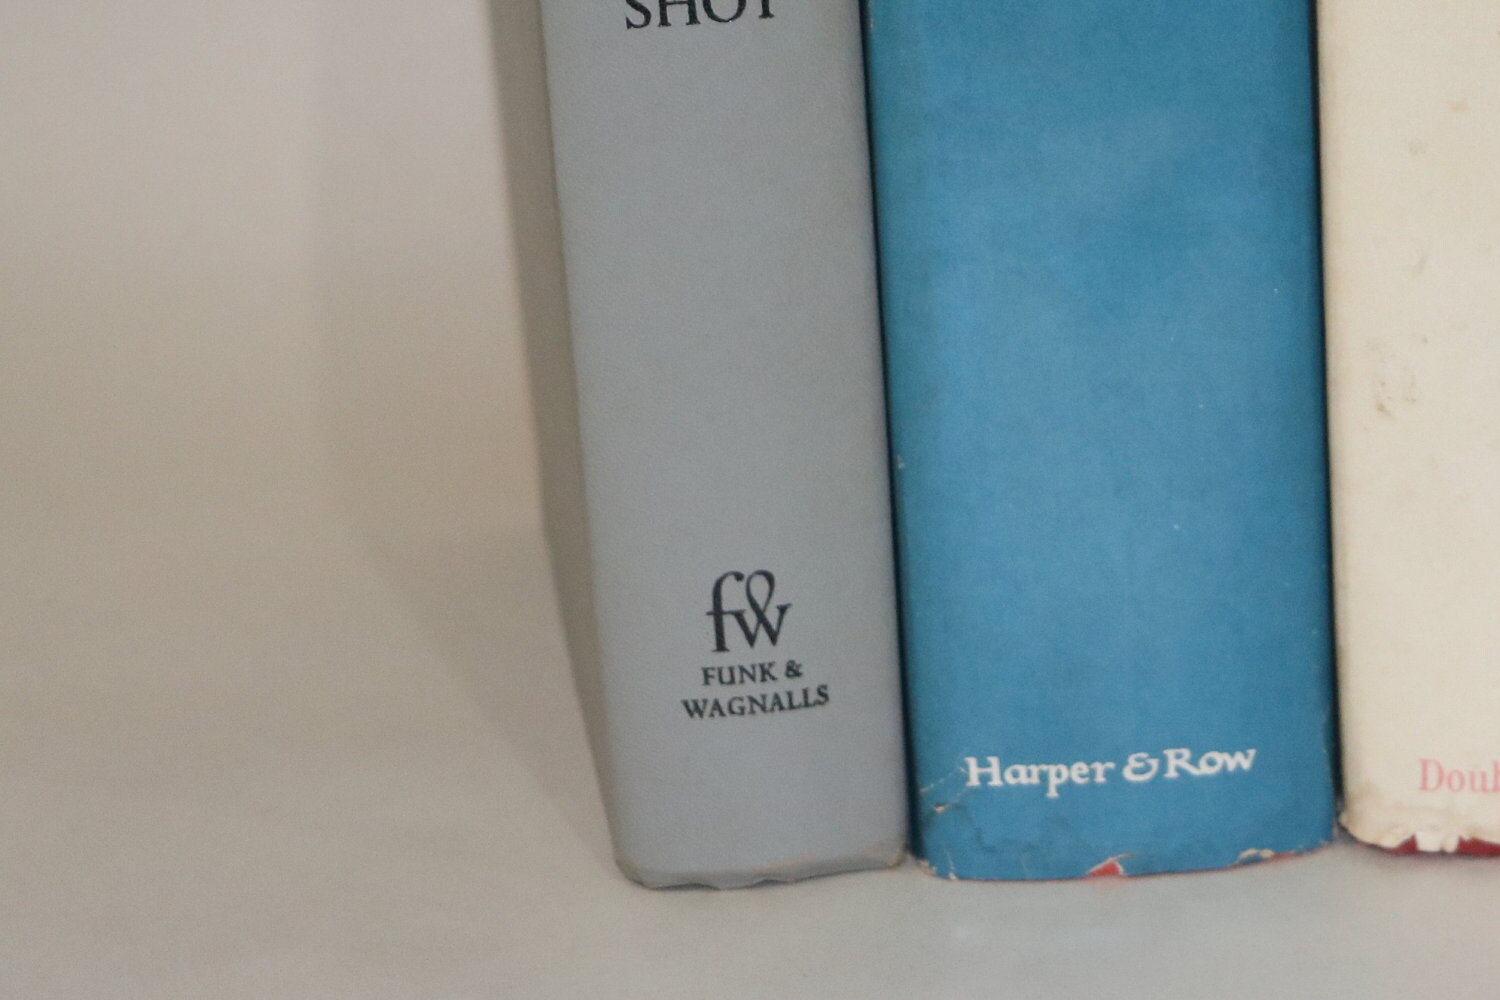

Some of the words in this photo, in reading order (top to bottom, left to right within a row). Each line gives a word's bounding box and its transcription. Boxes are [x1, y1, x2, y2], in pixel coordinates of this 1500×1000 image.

[701, 660, 778, 687] FUNK
[784, 659, 804, 680] &
[680, 684, 831, 720] WAGNALLS
[963, 755, 1116, 799] Harper
[1122, 751, 1160, 783] &
[1162, 748, 1258, 779] Row
